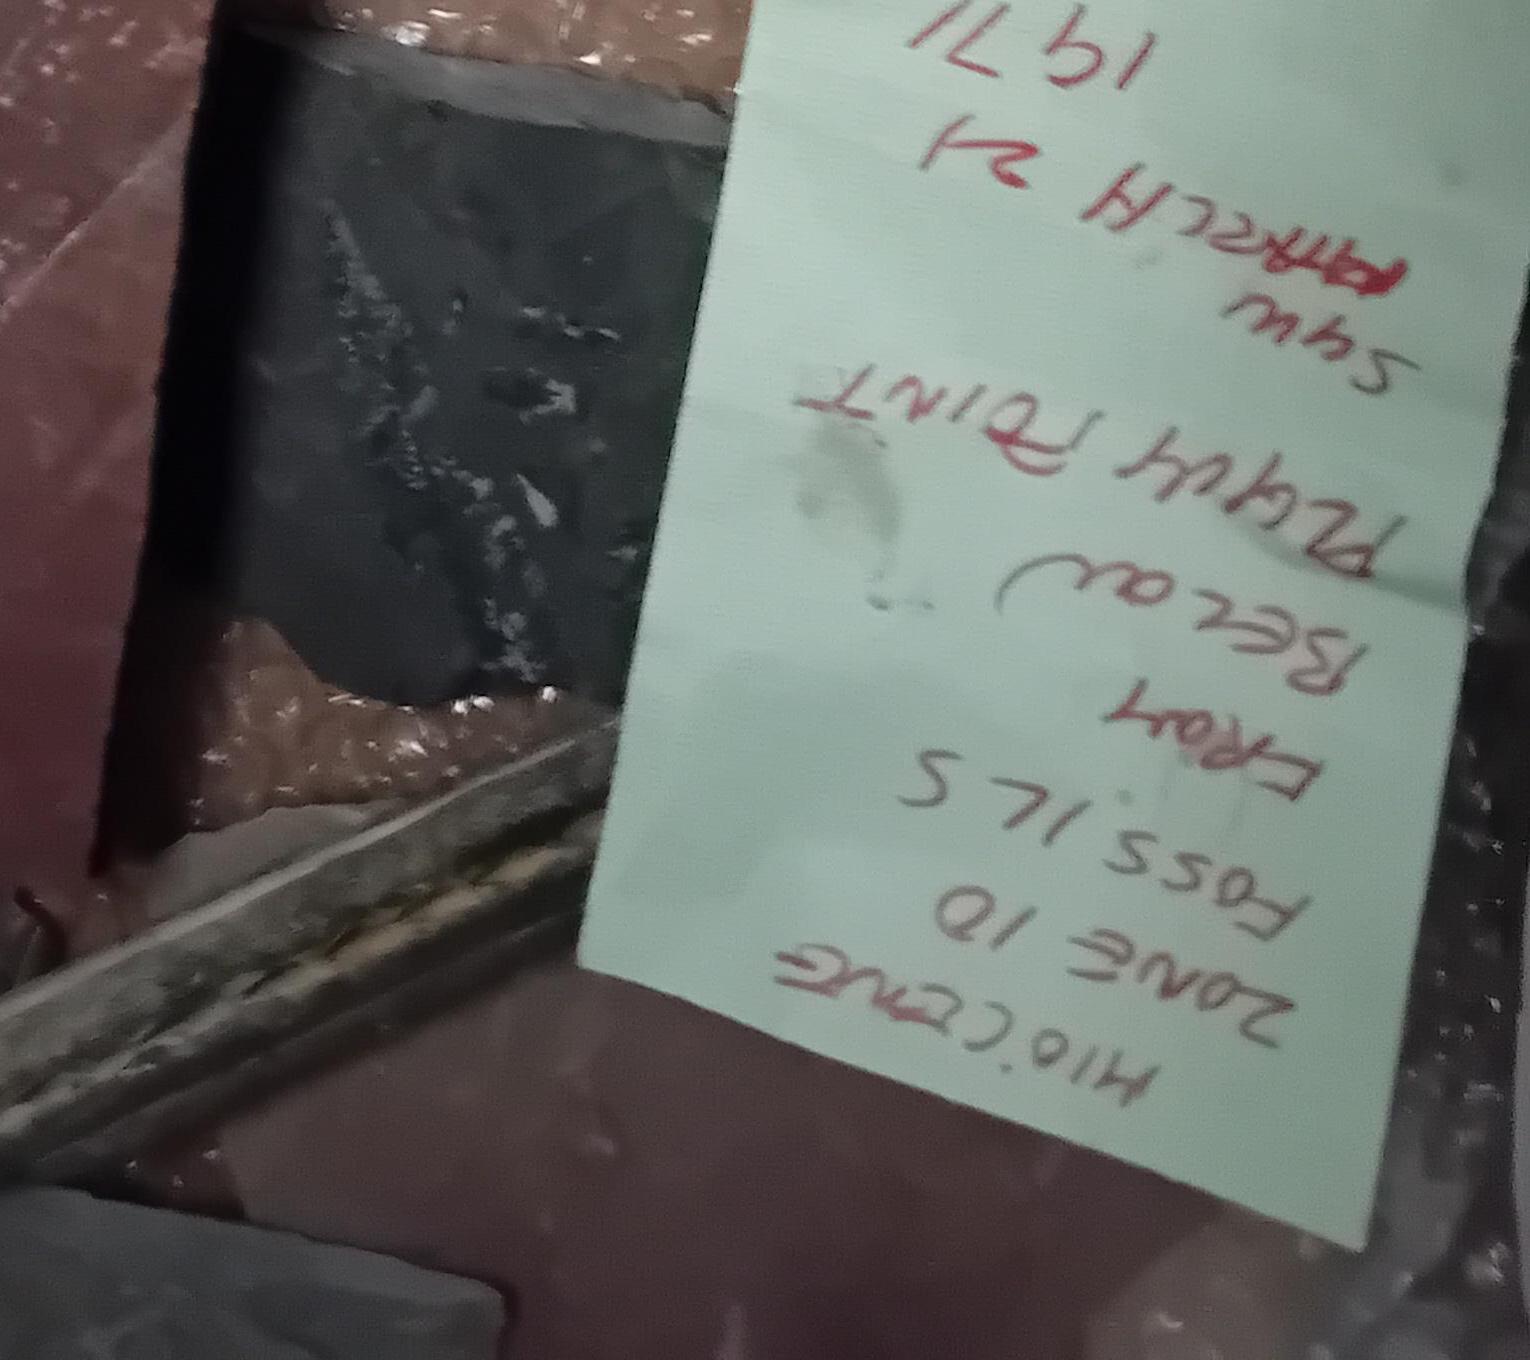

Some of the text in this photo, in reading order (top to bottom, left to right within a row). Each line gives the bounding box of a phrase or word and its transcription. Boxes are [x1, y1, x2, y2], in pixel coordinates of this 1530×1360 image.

[916, 113, 1407, 295] MARCH 21
[793, 364, 1103, 476] POINT
[994, 554, 1368, 696] BELOW
[1101, 678, 1323, 802] FROM
[896, 748, 1312, 942] FOSSILS
[933, 885, 1295, 1049] ZONE 10
